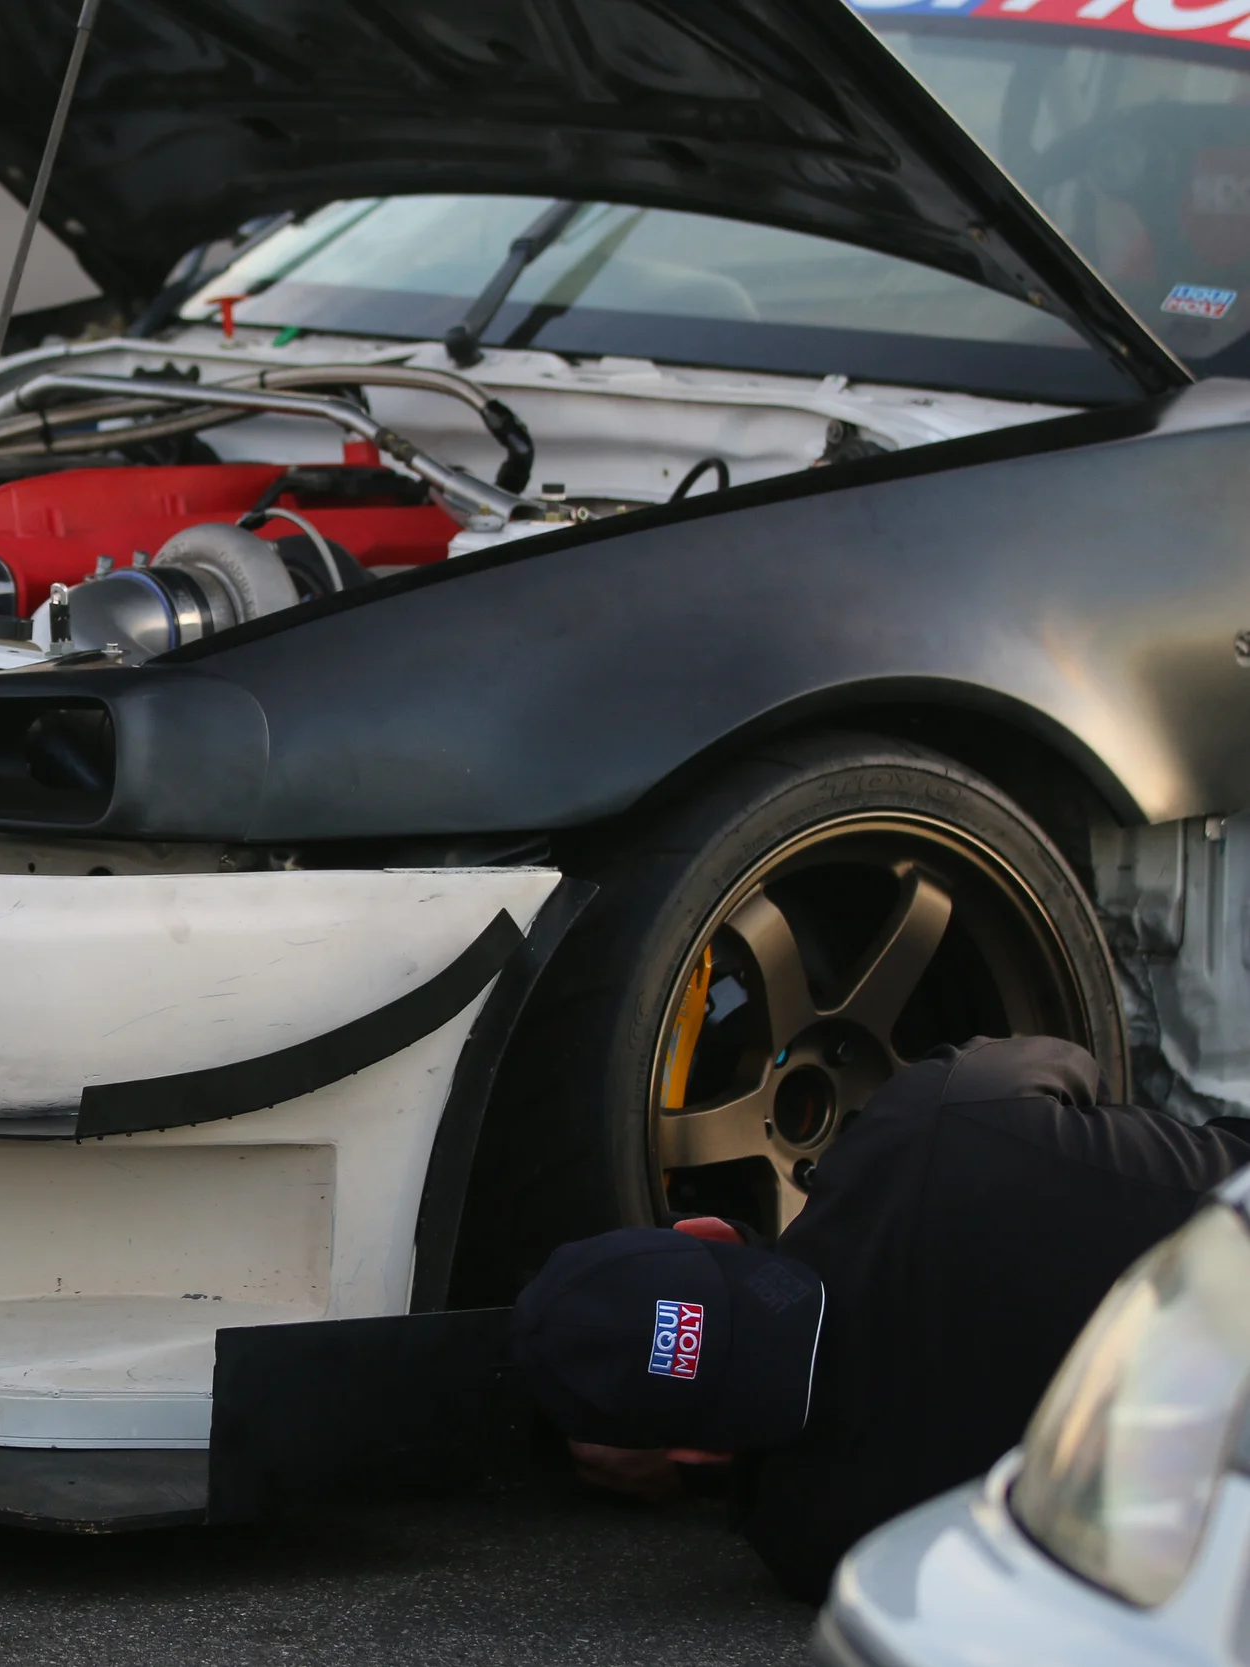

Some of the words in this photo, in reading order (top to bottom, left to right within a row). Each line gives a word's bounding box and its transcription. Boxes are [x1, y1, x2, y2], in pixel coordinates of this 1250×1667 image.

[1163, 297, 1223, 317] MOLY
[652, 1305, 679, 1369] LIQUI
[674, 1306, 701, 1374] MOLY
